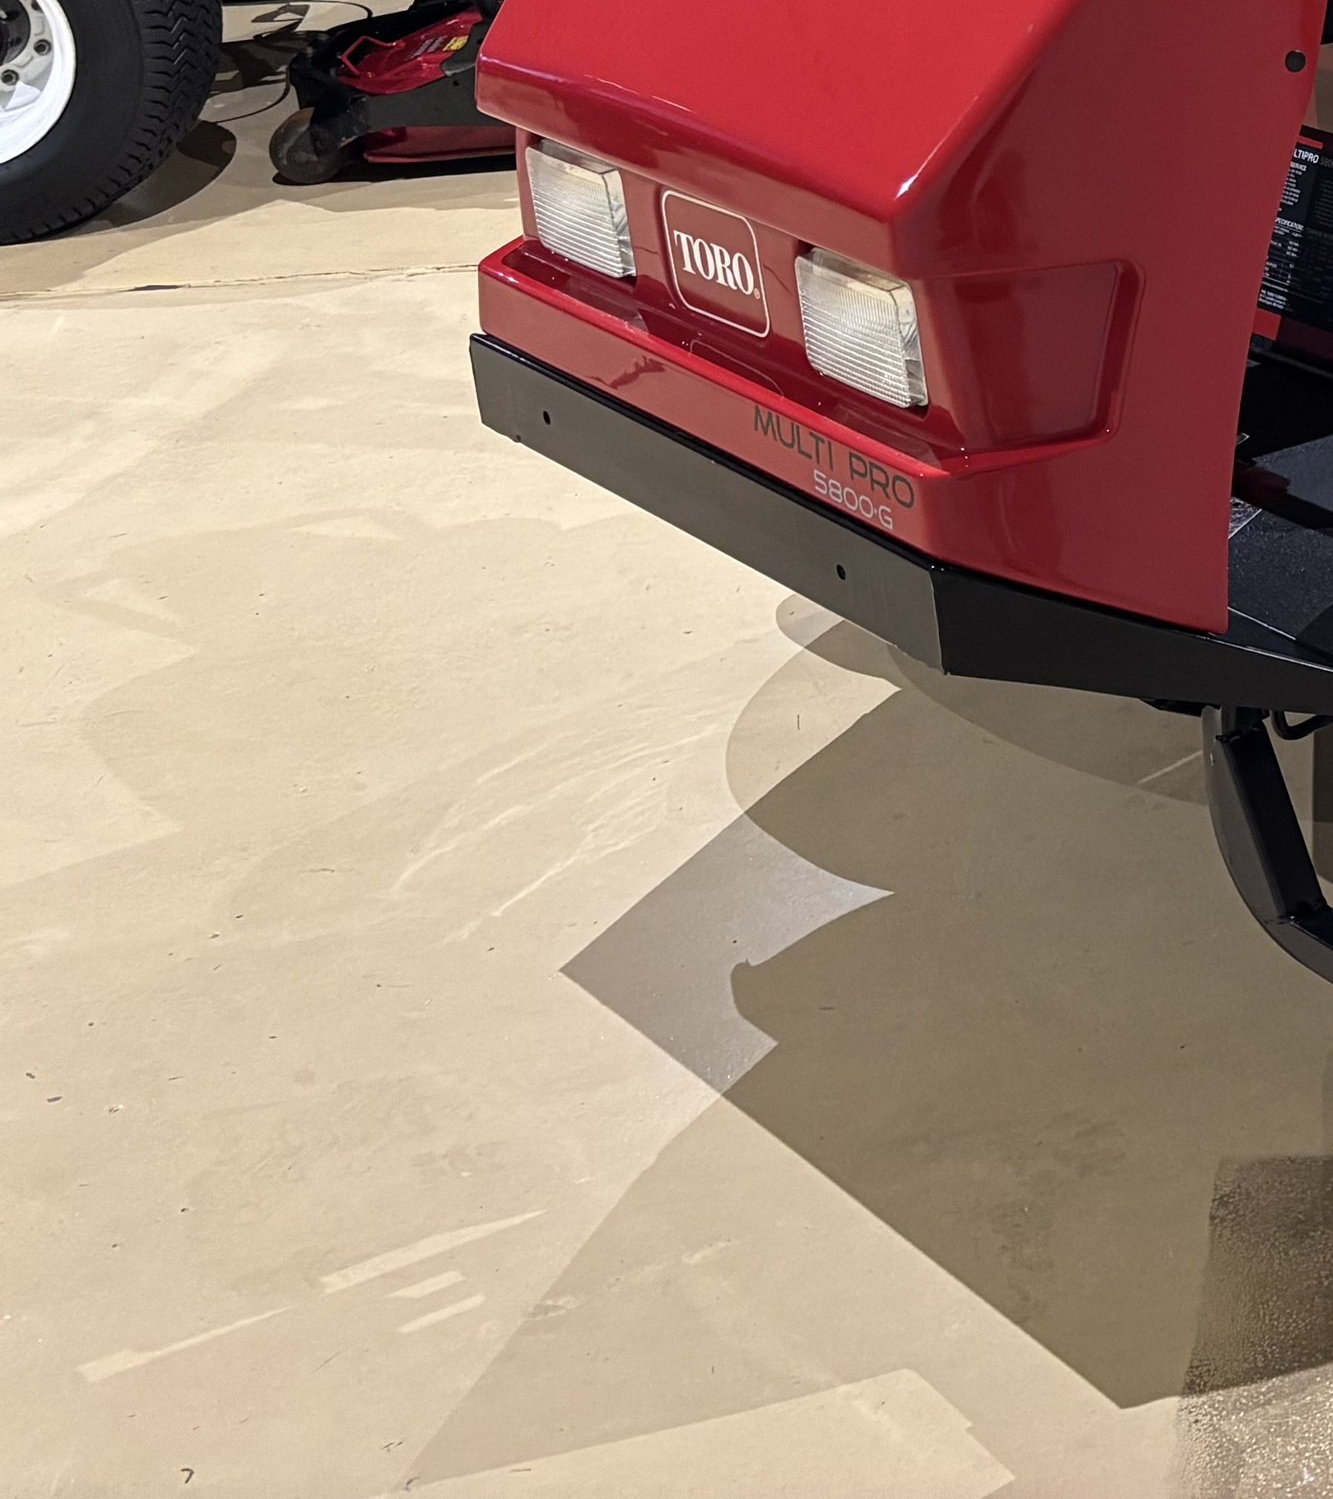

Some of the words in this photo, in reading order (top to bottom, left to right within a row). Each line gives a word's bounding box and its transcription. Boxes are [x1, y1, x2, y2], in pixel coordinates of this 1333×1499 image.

[1293, 148, 1319, 164] LTIPRO
[673, 229, 754, 295] TORO
[753, 405, 834, 471] MULTI
[848, 451, 915, 509] PRO
